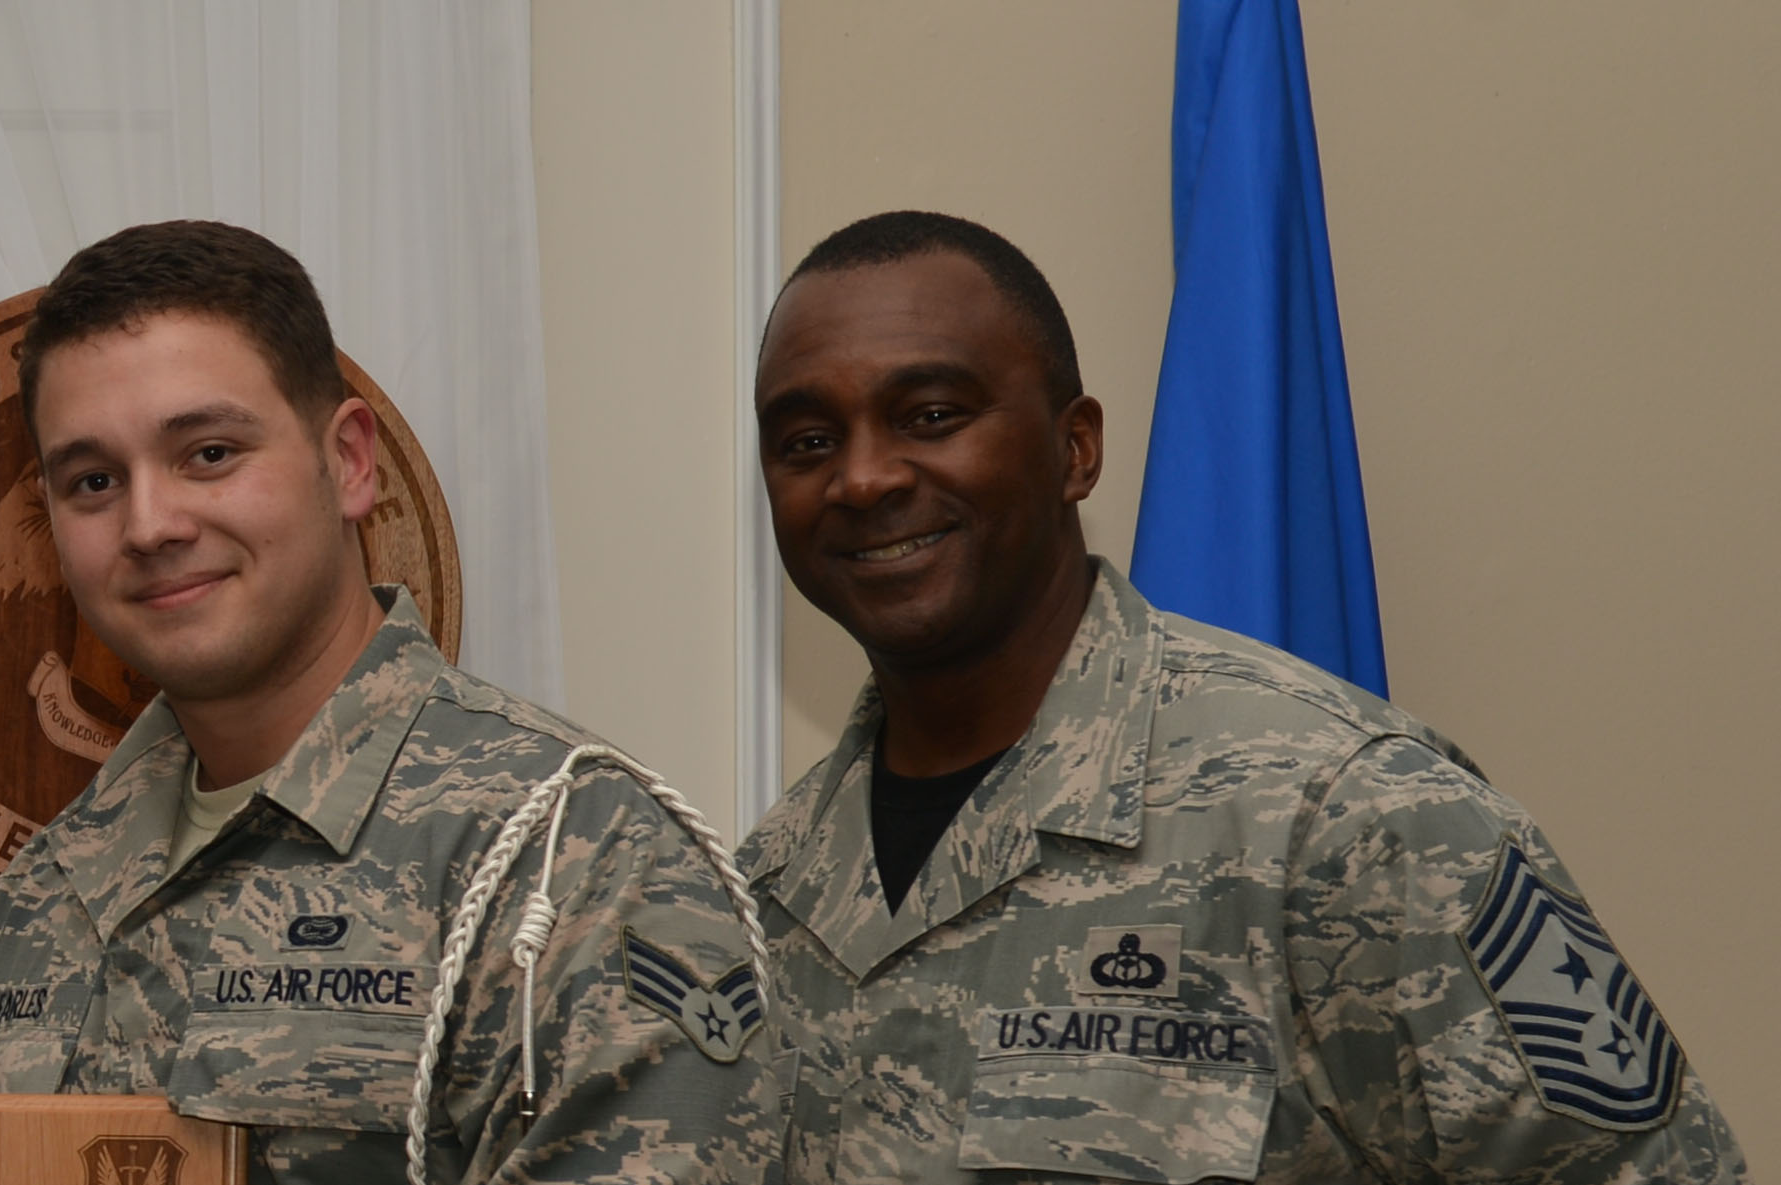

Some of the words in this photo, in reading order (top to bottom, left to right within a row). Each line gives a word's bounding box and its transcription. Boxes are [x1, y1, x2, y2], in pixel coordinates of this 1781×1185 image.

[43, 692, 110, 748] KNOWLEDGE
[216, 969, 255, 1003] U.S.
[262, 967, 311, 1003] AIR
[317, 968, 414, 1006] FORCE
[1057, 1011, 1120, 1052] AIR
[1130, 1016, 1248, 1062] FORCE
